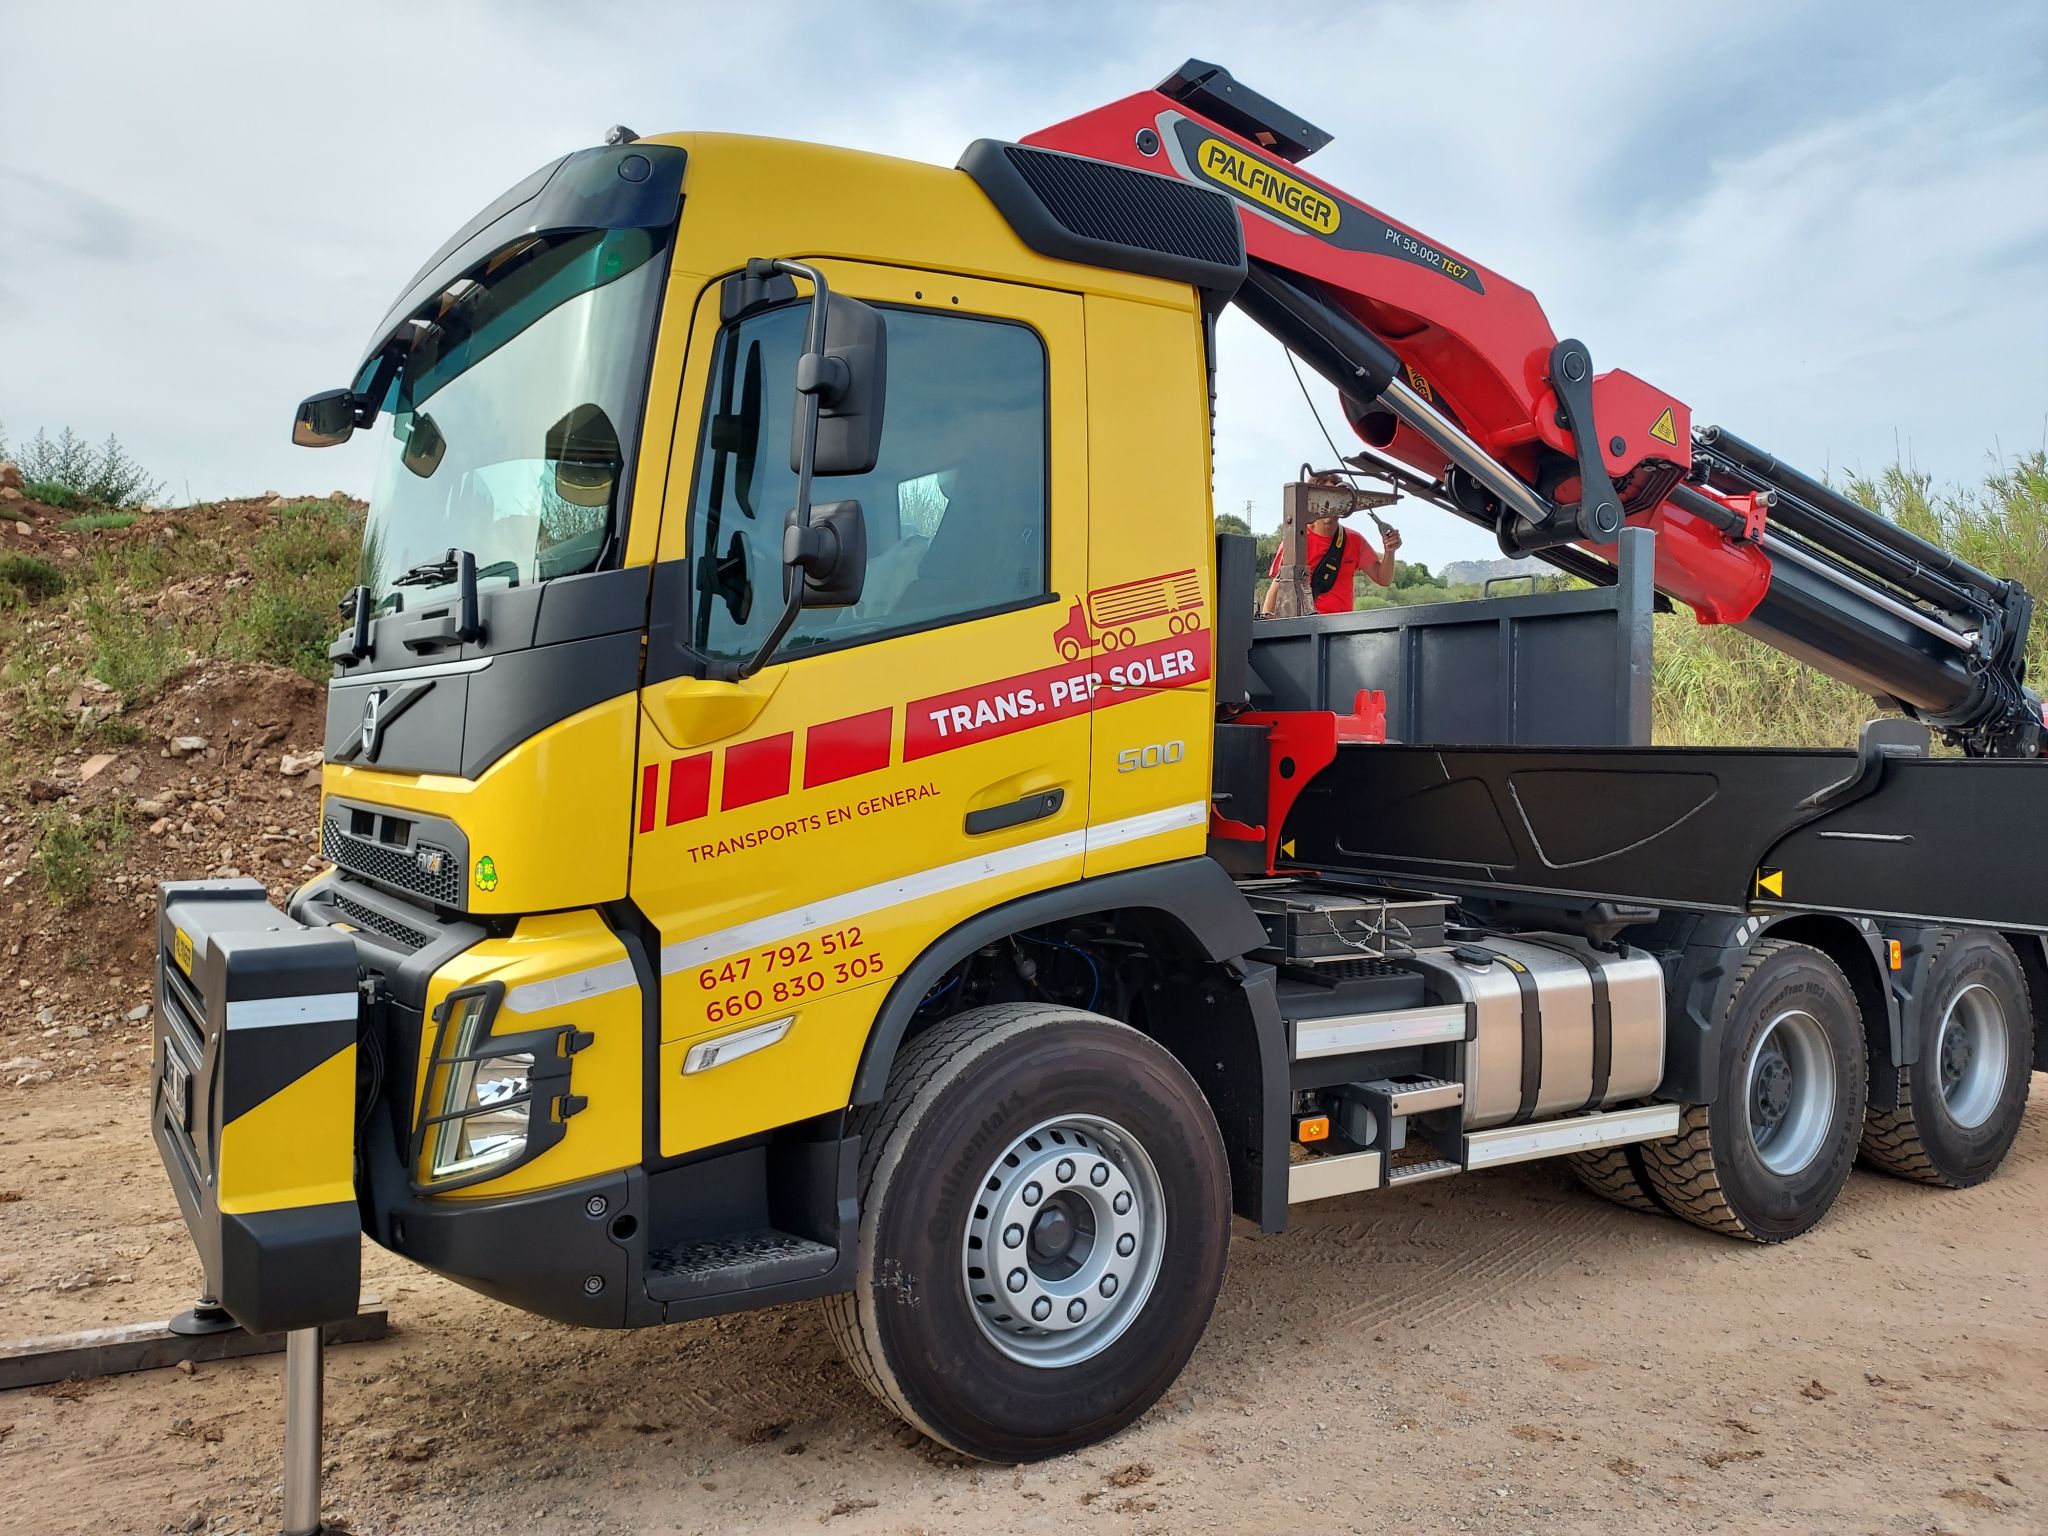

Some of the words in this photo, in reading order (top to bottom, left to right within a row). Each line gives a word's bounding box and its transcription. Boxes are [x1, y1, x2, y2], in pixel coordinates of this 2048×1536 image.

[1206, 145, 1332, 228] PALFINGER
[1385, 228, 1402, 246] PK
[1402, 237, 1440, 266] 58.002
[1441, 257, 1469, 279] TEC7
[929, 688, 1045, 737] TRANS.
[1049, 672, 1103, 709] PEP
[1109, 649, 1196, 691] SOLER
[1117, 739, 1186, 773] 500
[687, 814, 822, 863] TRANSPORTS
[826, 805, 852, 826] EN
[856, 782, 941, 817] GENERAL
[699, 957, 752, 990] 647
[761, 941, 814, 973] 792
[821, 926, 864, 955] 512
[706, 990, 764, 1022] 660
[772, 971, 825, 1003] 830
[833, 952, 884, 984] 305
